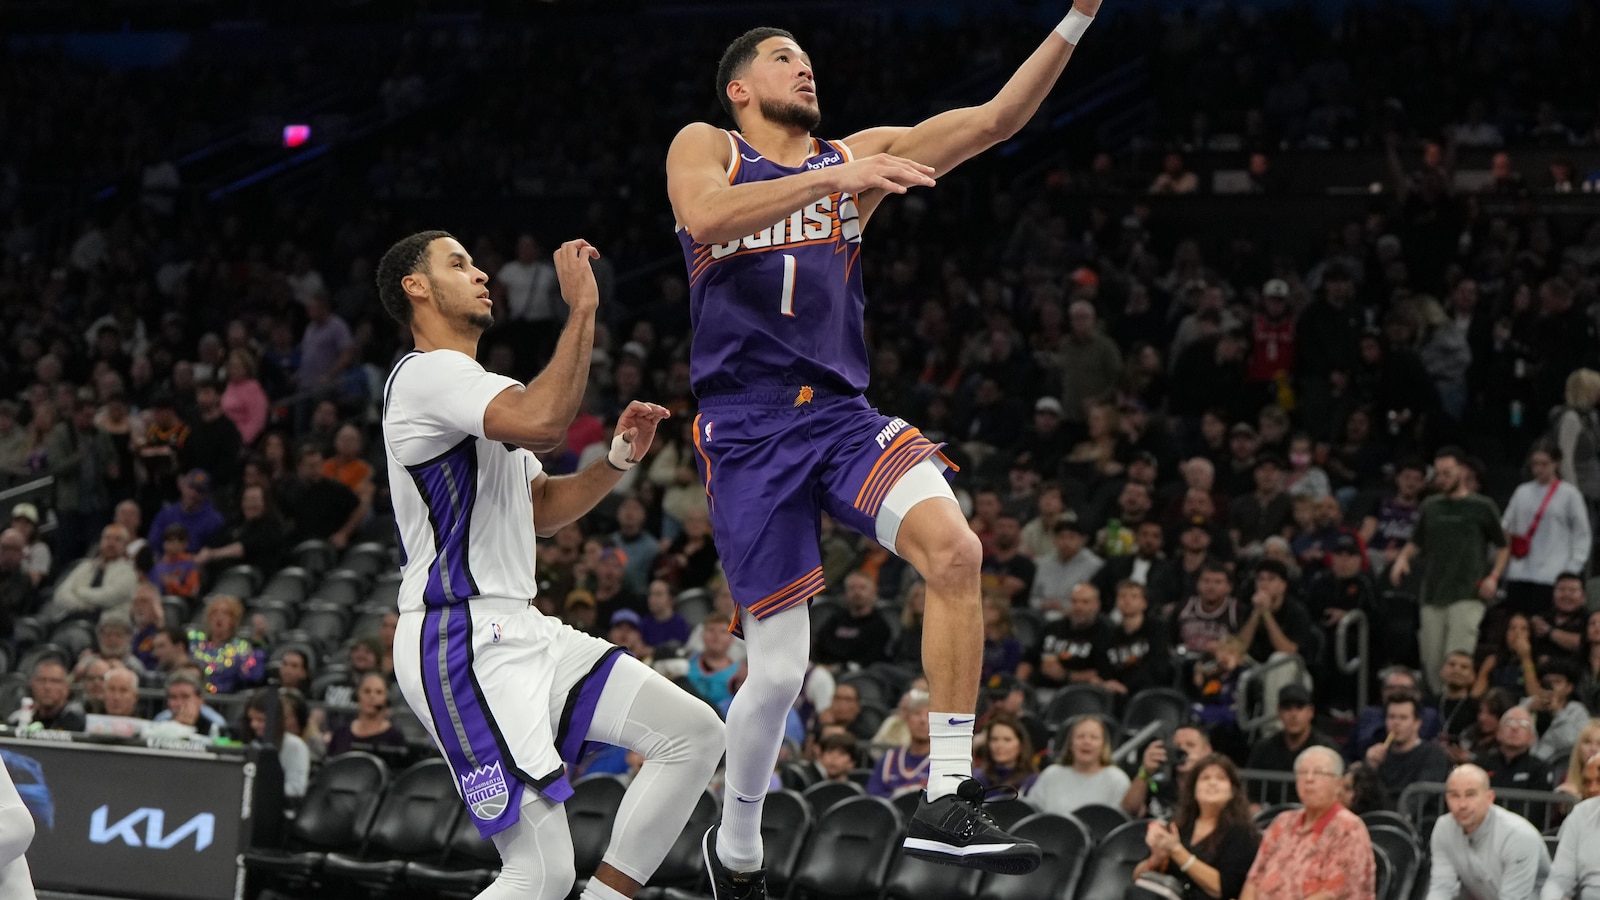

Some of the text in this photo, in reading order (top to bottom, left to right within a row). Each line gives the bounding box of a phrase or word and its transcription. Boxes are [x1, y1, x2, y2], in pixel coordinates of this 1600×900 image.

[807, 153, 840, 170] PayPal
[781, 254, 796, 317] 1
[875, 418, 910, 449] PHOE
[468, 783, 506, 805] KINGS
